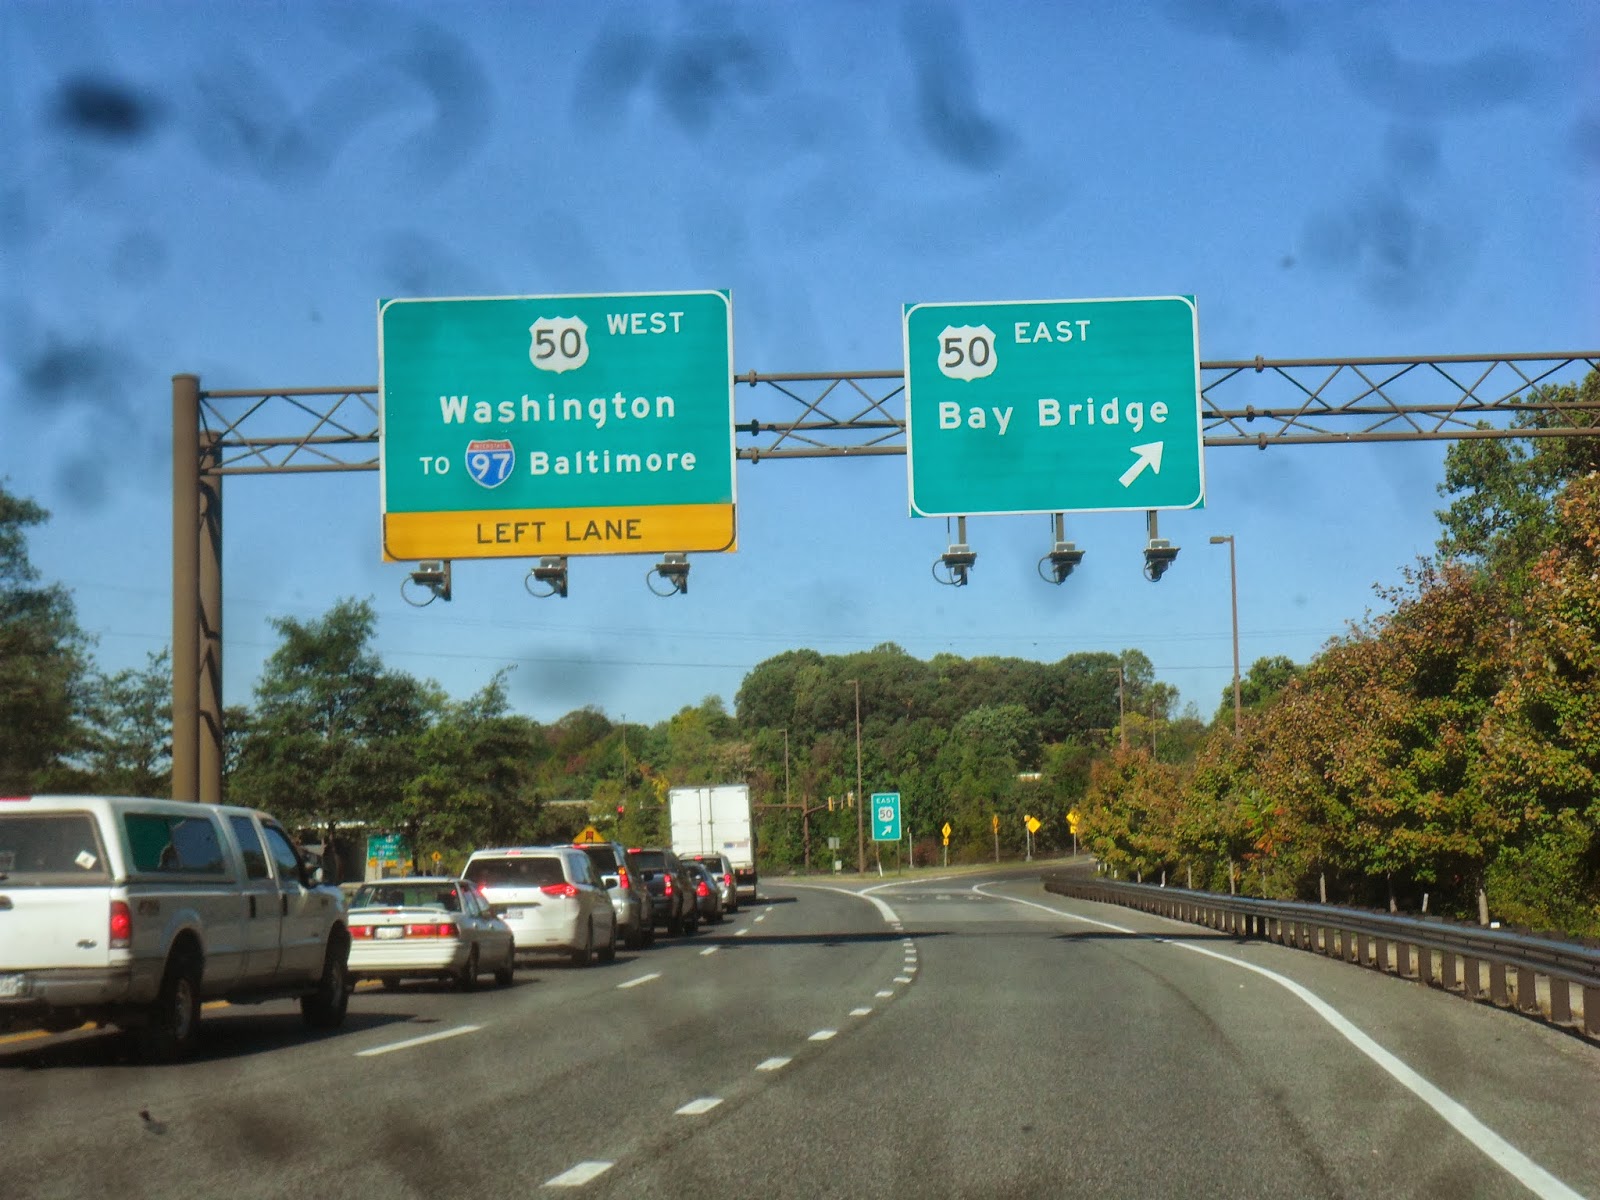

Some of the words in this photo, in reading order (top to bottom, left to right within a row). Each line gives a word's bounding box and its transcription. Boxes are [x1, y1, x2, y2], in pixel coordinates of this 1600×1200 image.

[535, 327, 582, 360] 50
[607, 311, 685, 336] WEST
[943, 336, 990, 368] 50
[1014, 319, 1091, 343] EAST
[439, 391, 676, 429] Washington
[938, 401, 1014, 436] Bay
[1037, 397, 1169, 433] Bridge
[419, 455, 451, 476] TO
[471, 453, 510, 480] 97
[529, 450, 697, 476] Baltimore
[476, 521, 547, 544] LEFT
[565, 518, 643, 542] LANE
[880, 809, 892, 819] 50
